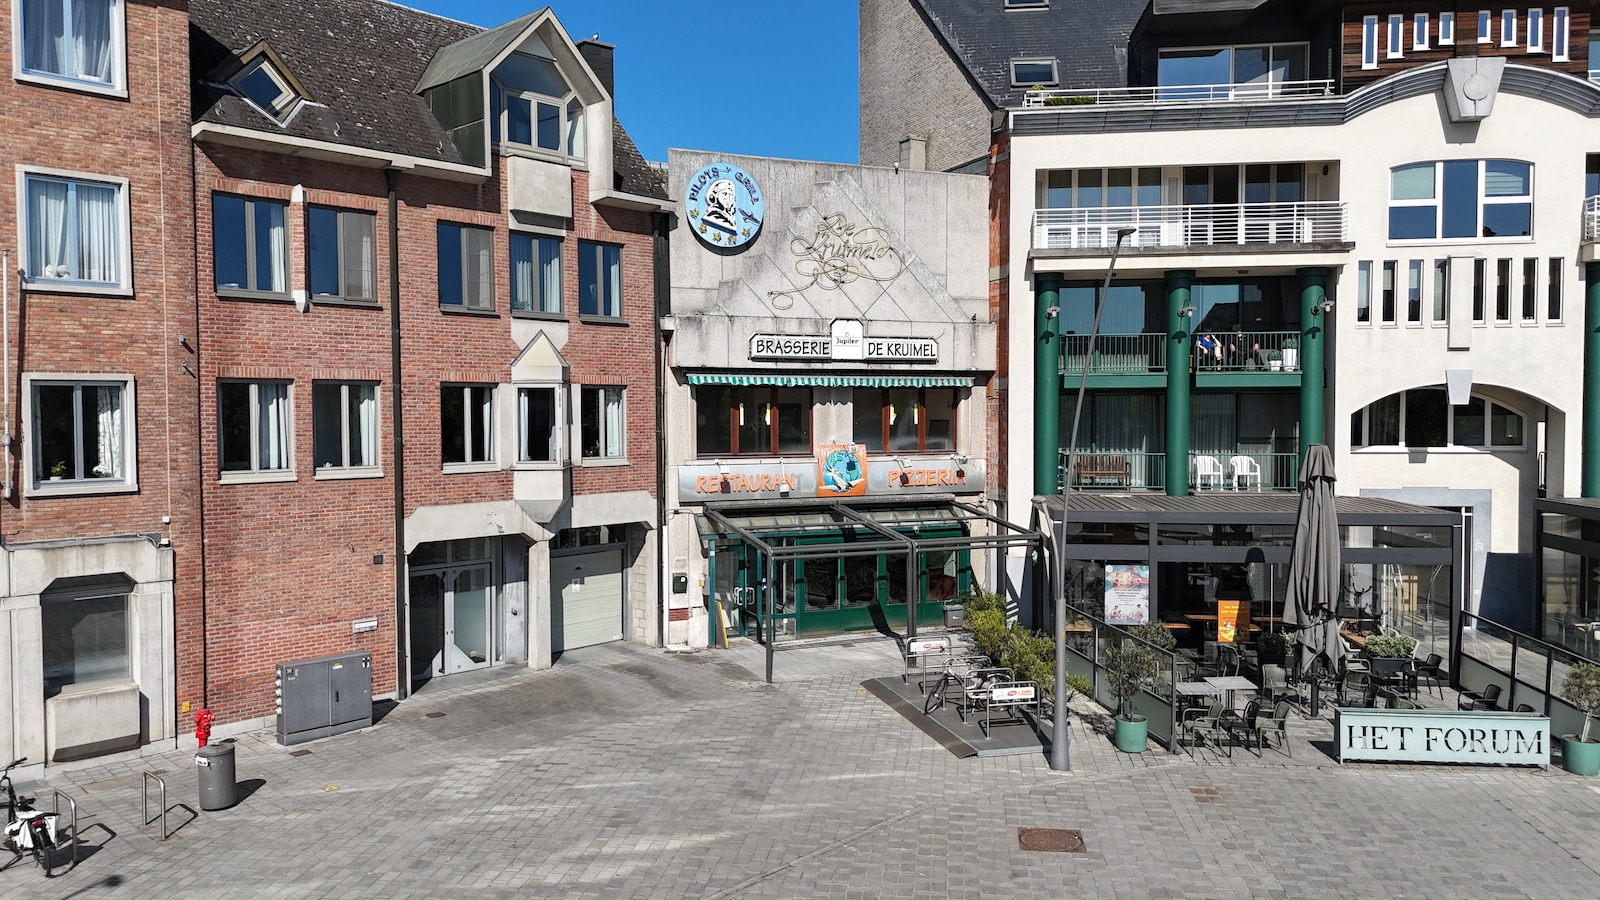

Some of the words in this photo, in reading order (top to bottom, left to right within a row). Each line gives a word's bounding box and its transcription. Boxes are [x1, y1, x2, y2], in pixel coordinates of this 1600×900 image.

[689, 167, 720, 201] PILOTS
[734, 171, 760, 205] GRILL
[756, 339, 830, 355] BRASSERIE
[868, 342, 883, 356] DE
[886, 342, 936, 357] KRUIMEL
[835, 337, 859, 345] Jupiler
[1347, 725, 1413, 751] HET
[1424, 727, 1544, 755] FORUM
